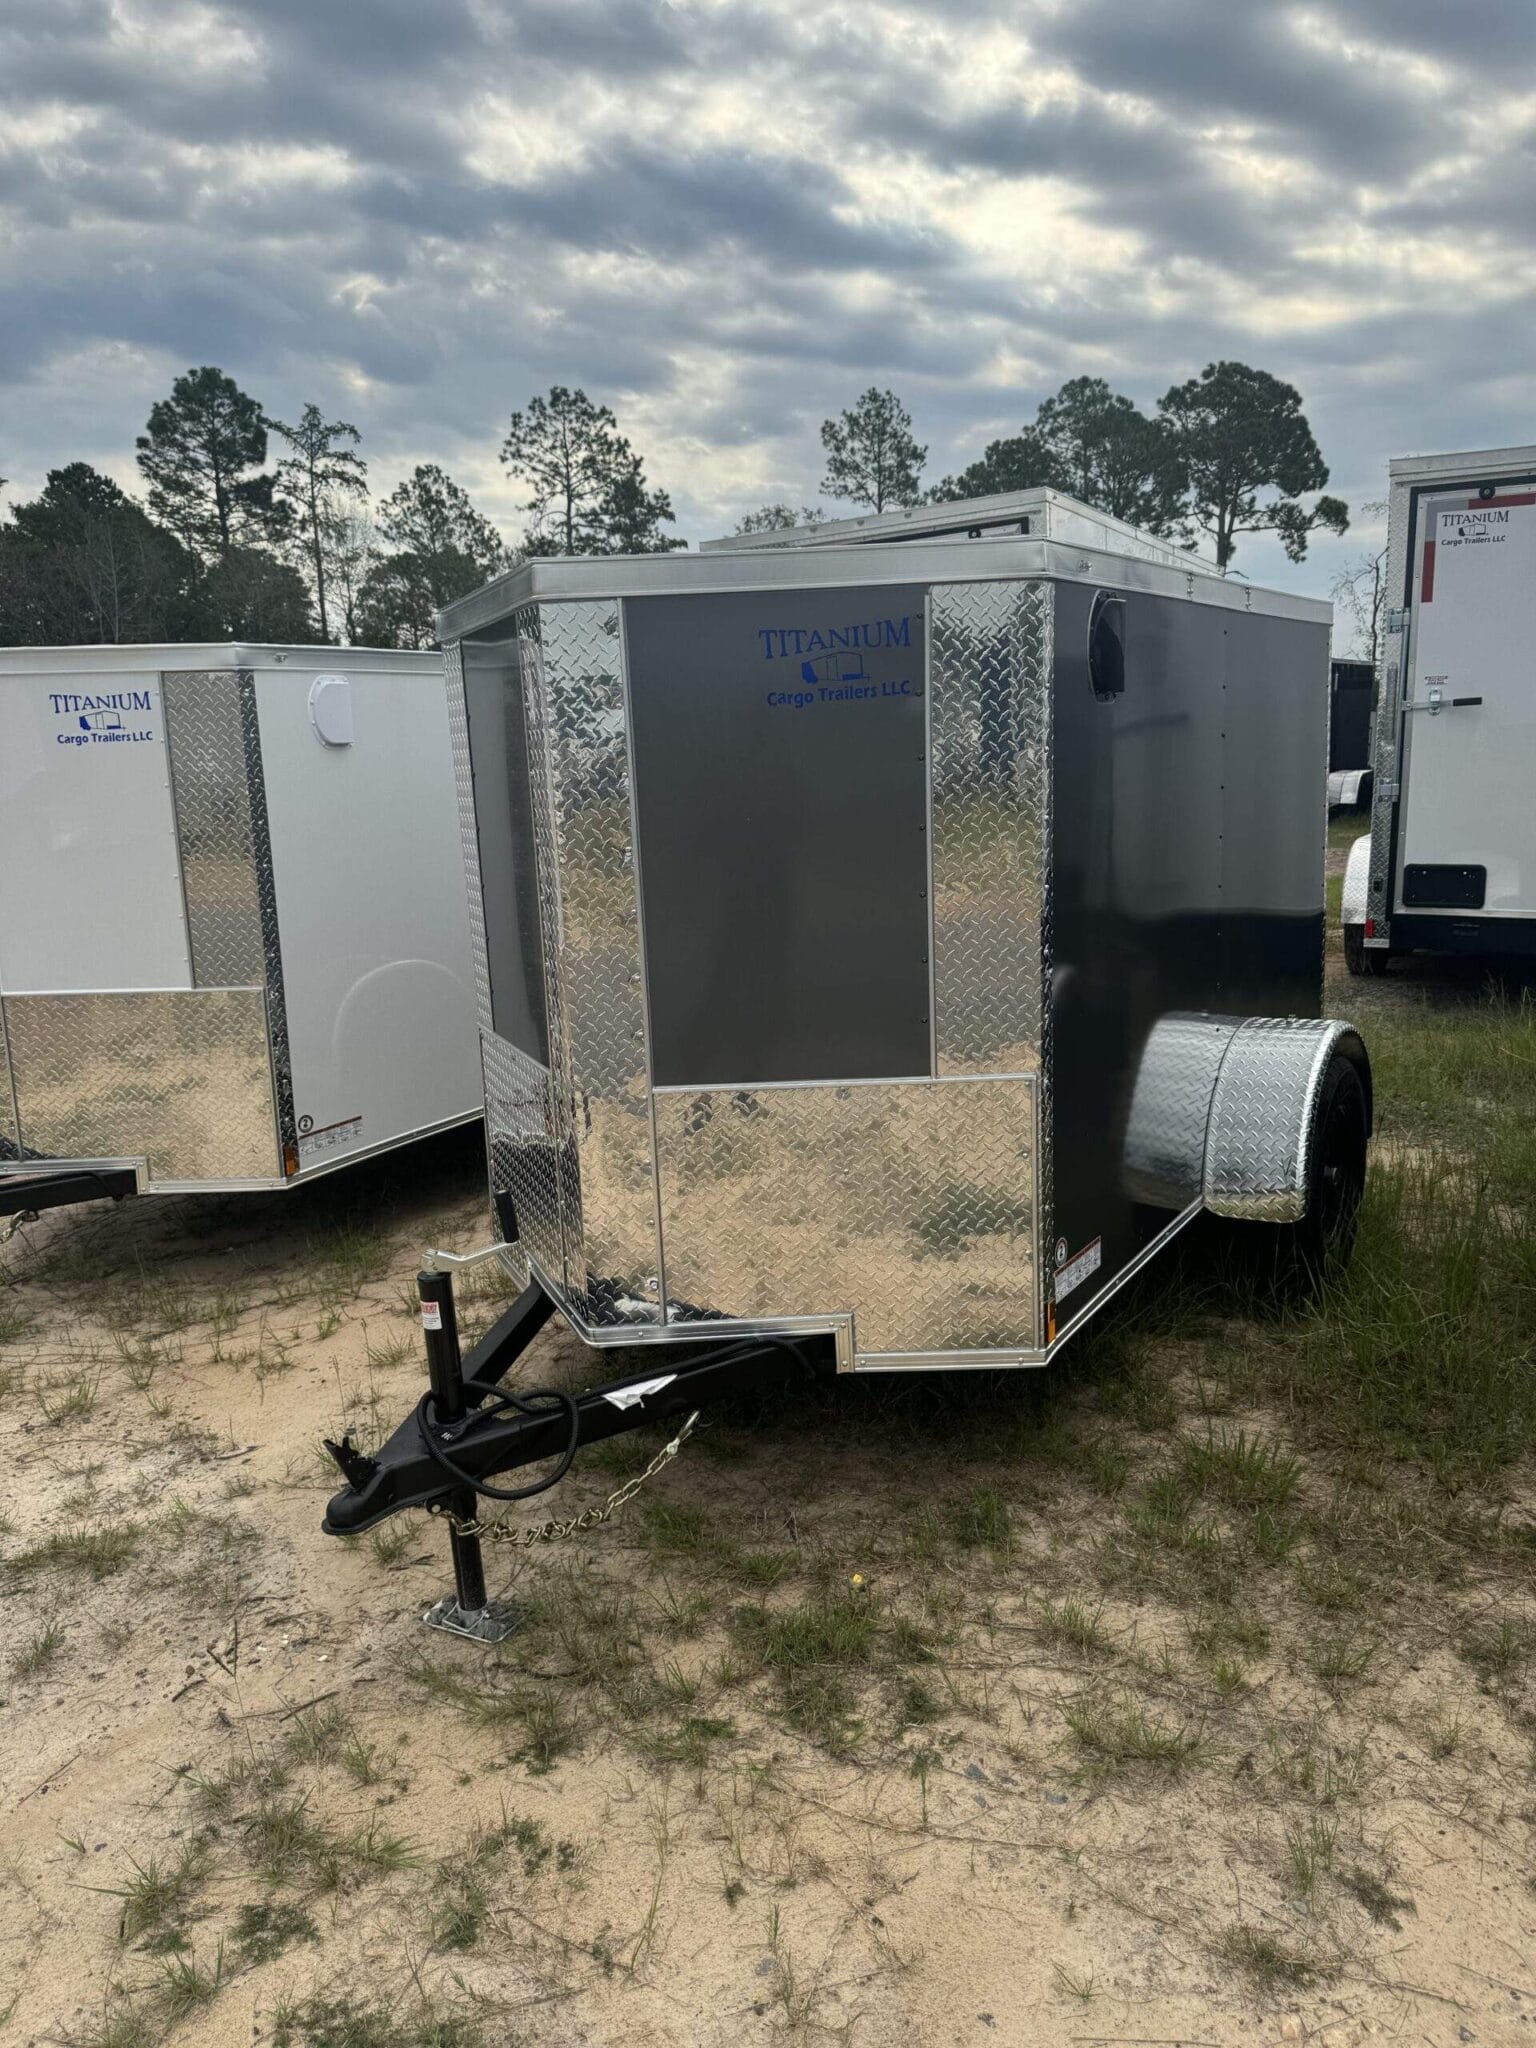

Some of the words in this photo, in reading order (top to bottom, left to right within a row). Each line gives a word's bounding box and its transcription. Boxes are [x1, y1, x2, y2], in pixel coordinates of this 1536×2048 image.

[1442, 510, 1510, 527] TITANIUM
[1441, 539, 1463, 547] Cargo
[758, 617, 911, 659] TITANIUM
[49, 691, 152, 714] TITANIUM
[767, 691, 814, 708] Cargo
[818, 685, 877, 703] Trailers
[882, 680, 911, 697] LLC
[57, 734, 89, 746] Cargo
[92, 732, 131, 743] Trailers
[133, 731, 153, 742] LLC
